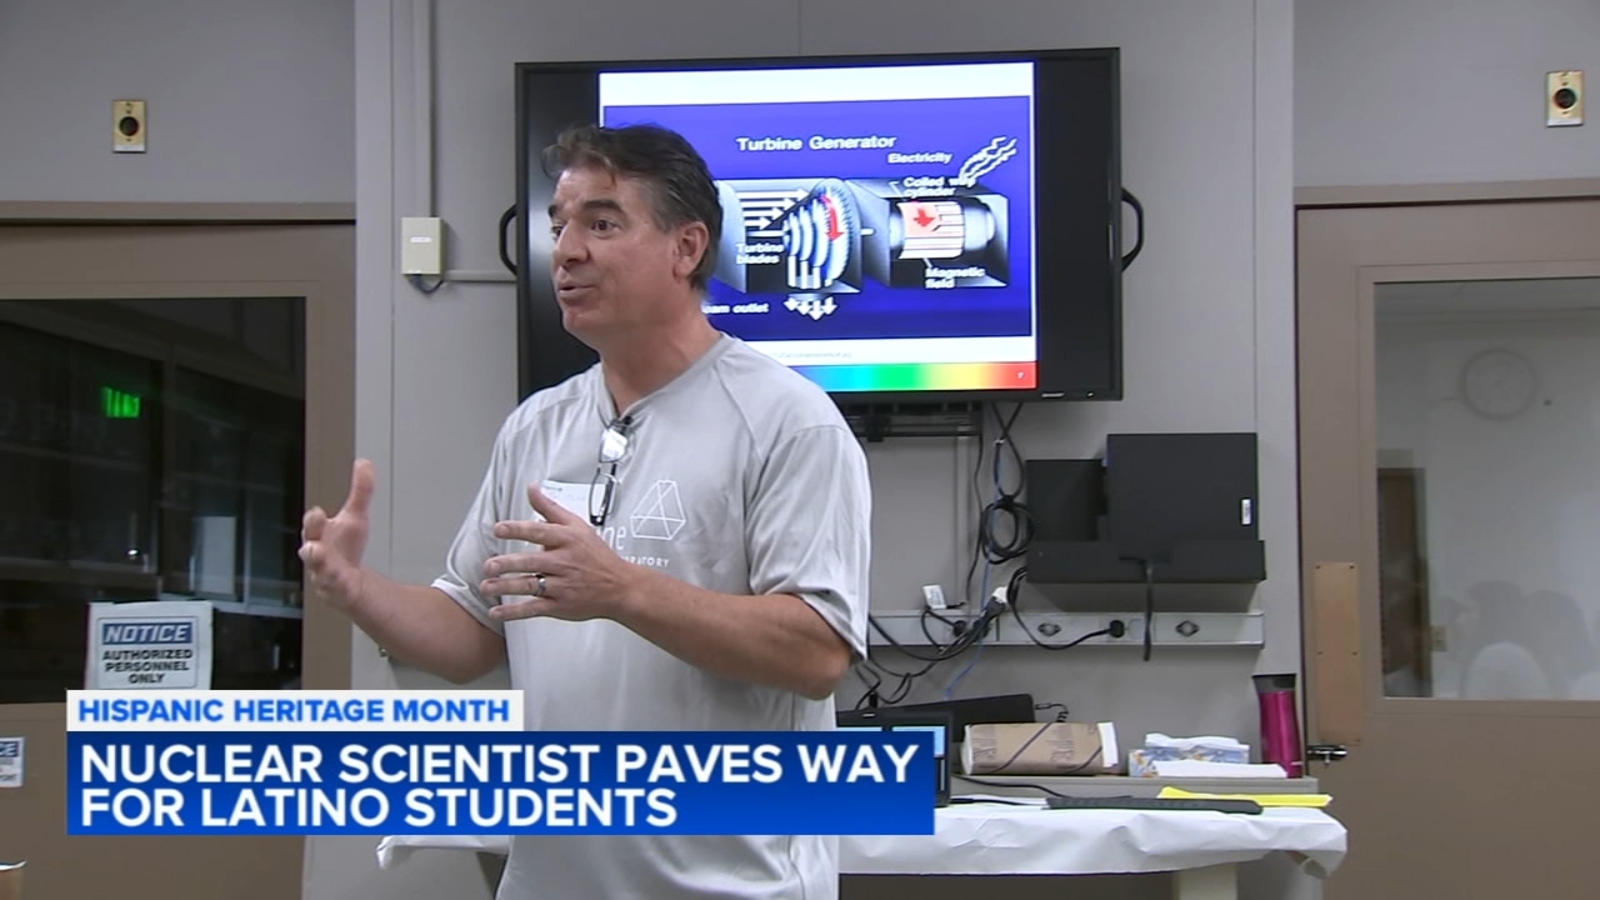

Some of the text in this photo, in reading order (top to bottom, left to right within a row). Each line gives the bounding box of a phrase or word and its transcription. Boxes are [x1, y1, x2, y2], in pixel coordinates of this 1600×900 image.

[736, 134, 897, 152] Turbine Generator
[887, 152, 953, 165] Electricity
[736, 242, 785, 255] Turbine
[736, 254, 780, 265] blades
[924, 266, 986, 280] Magnetic
[924, 278, 956, 289] field
[701, 302, 770, 315] eam outlet
[623, 555, 670, 567] RATORY
[104, 624, 190, 643] NOTICE
[102, 649, 194, 661] AUTHORIZED
[105, 661, 190, 673] PERSONNEL
[128, 673, 166, 685] ONLY
